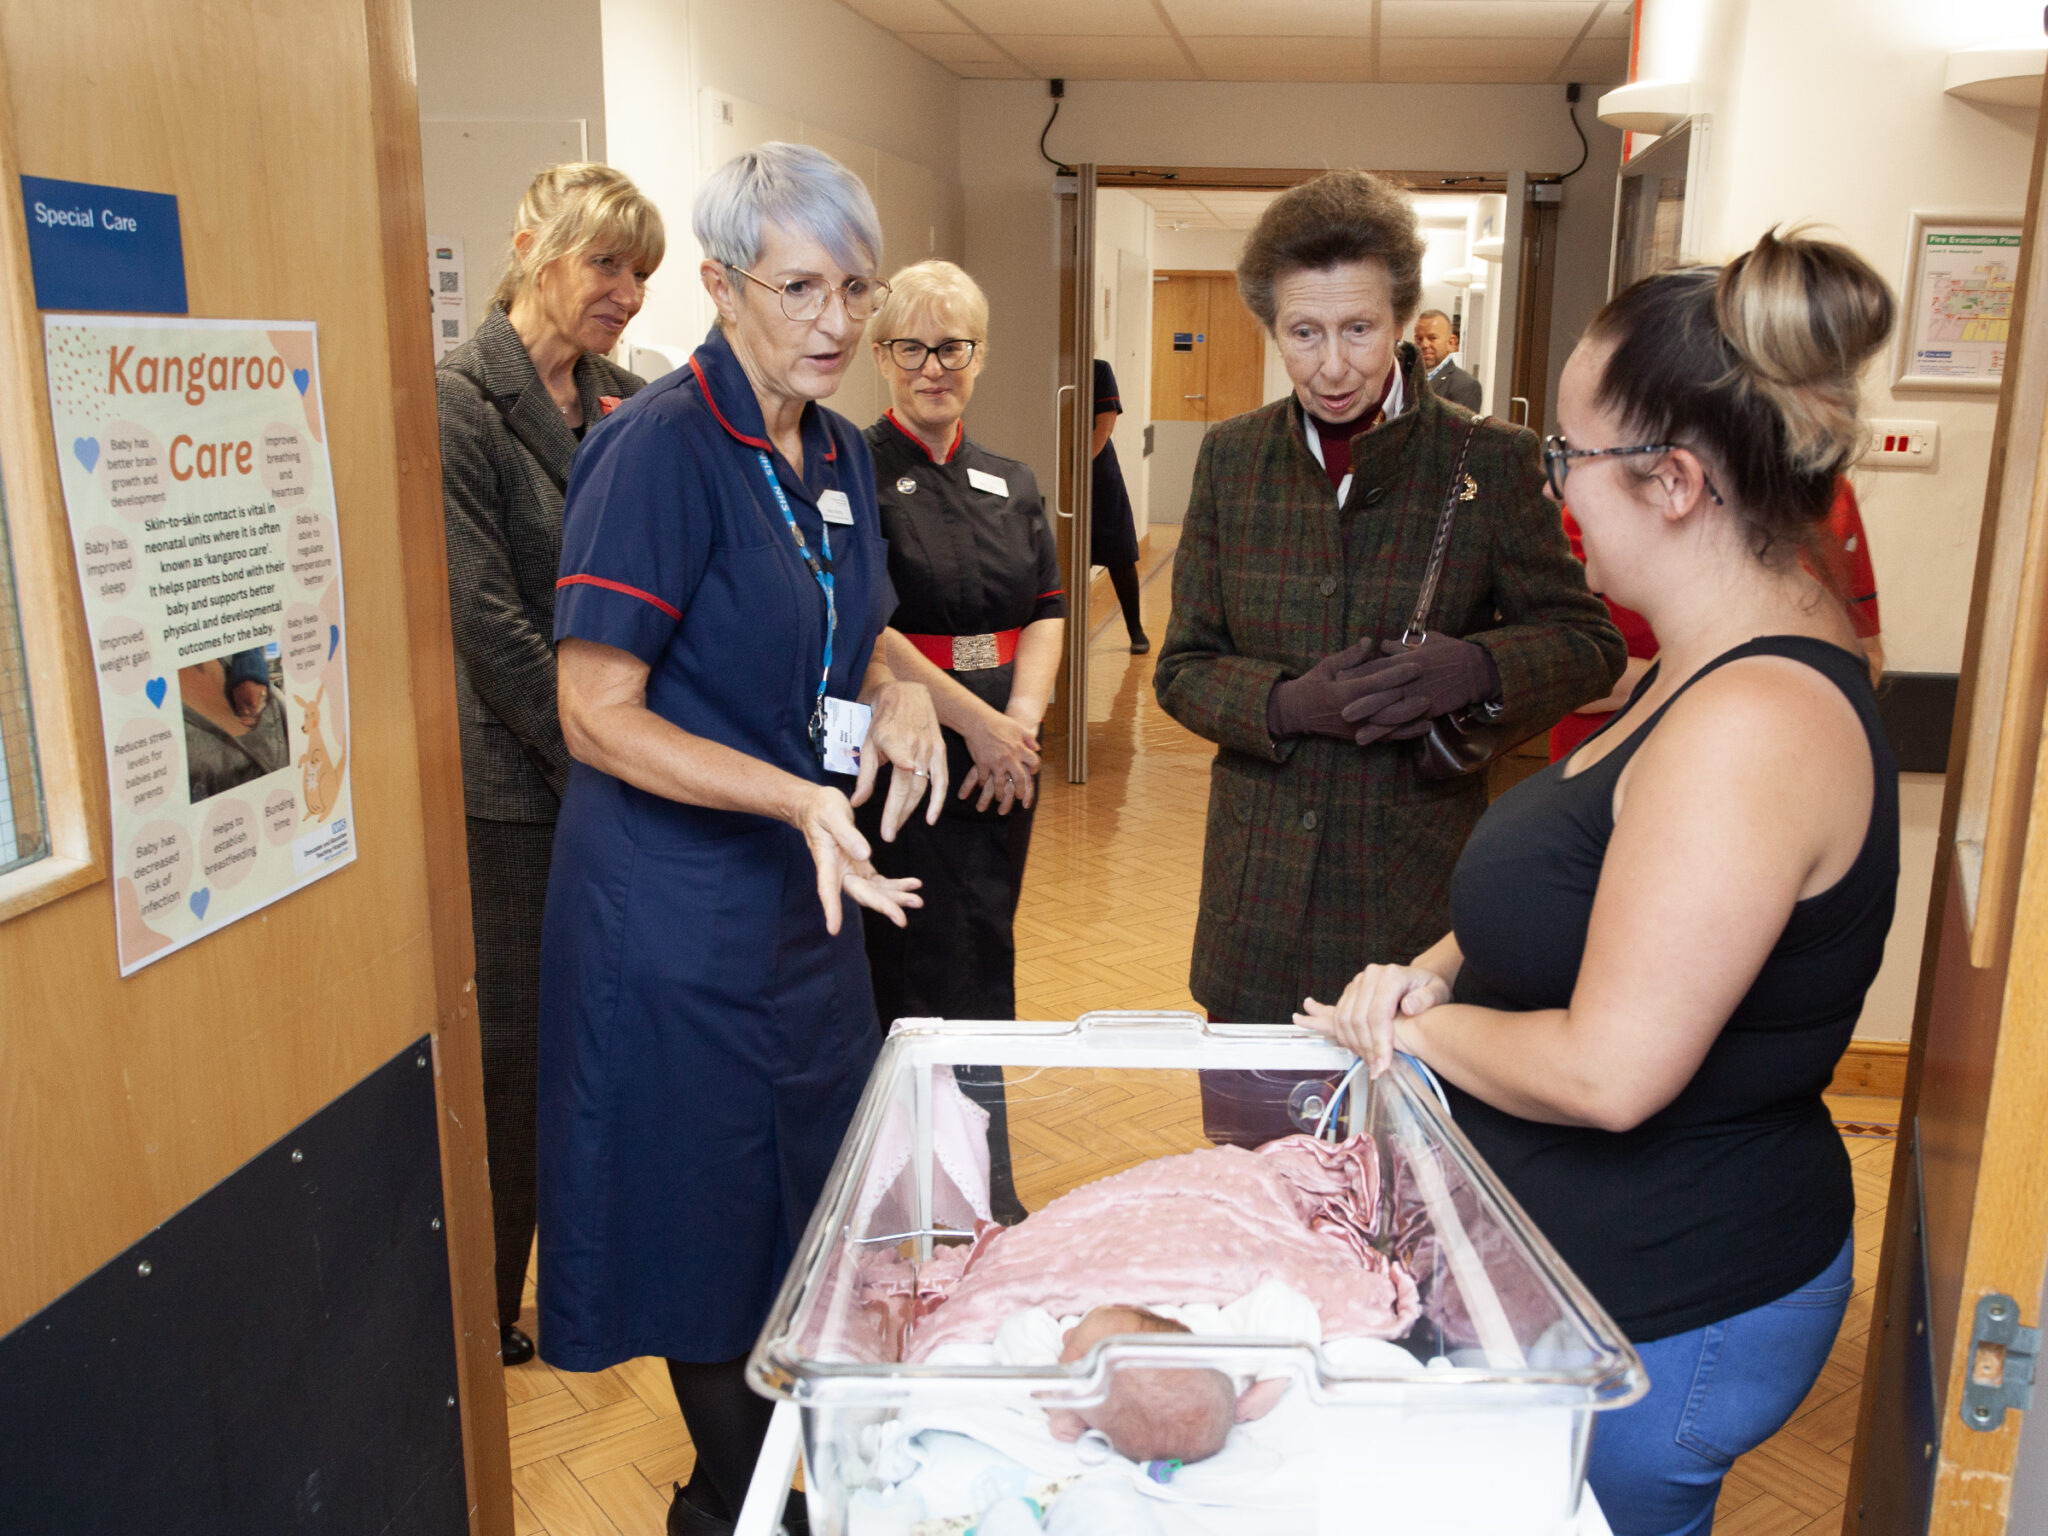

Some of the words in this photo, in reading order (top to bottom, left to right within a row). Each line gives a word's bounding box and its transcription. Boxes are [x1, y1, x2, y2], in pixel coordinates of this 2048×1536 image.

[34, 202, 94, 228] Special
[101, 209, 138, 233] Care
[1929, 235, 1947, 244] Fire
[1948, 235, 1998, 245] Evacuation
[1999, 236, 2020, 246] Plan
[108, 345, 285, 406] Kangaroo
[110, 439, 132, 452] Baby
[134, 438, 150, 449] has
[106, 459, 133, 470] better
[135, 456, 158, 468] brain
[169, 434, 253, 482] Care
[266, 452, 301, 464] breathing
[758, 451, 773, 476] NHS
[111, 477, 141, 491] growth
[143, 474, 159, 485] and
[279, 469, 293, 480] and
[110, 492, 167, 508] development
[773, 486, 790, 512] NHS
[144, 512, 201, 532] Skin-to-skin
[203, 508, 237, 524] contact
[238, 506, 246, 518] is
[247, 502, 266, 516] vital
[267, 502, 276, 513] in
[85, 541, 109, 555] Baby
[111, 538, 129, 550] has
[144, 535, 187, 554] neonatal
[188, 532, 211, 547] units
[213, 529, 240, 543] where
[241, 526, 248, 538] it
[249, 525, 257, 536] is
[258, 522, 281, 535] often
[86, 557, 133, 577] improved
[160, 558, 191, 573] known
[193, 556, 203, 567] as
[100, 582, 126, 596] sleep
[149, 584, 158, 598] It
[158, 581, 185, 597] helps
[186, 574, 220, 593] parents
[222, 568, 244, 583] bond
[246, 564, 265, 578] with
[265, 559, 286, 575] their
[166, 601, 190, 617] baby
[191, 596, 208, 611] and
[209, 589, 248, 607] supports
[249, 583, 276, 598] better
[163, 617, 201, 642] physical
[202, 614, 219, 629] and
[220, 600, 283, 624] developmental
[99, 629, 144, 650] Improved
[178, 638, 222, 656] outcomes
[223, 632, 236, 645] for
[237, 627, 252, 640] the
[253, 622, 276, 638] baby.
[100, 655, 131, 672] weight
[132, 649, 151, 667] gain
[114, 738, 148, 757] Reduces
[149, 730, 172, 745] stress
[127, 755, 150, 770] levels
[151, 750, 162, 761] for
[125, 773, 152, 789] babies
[153, 764, 167, 779] and
[133, 785, 164, 806] parents
[265, 797, 295, 818] Bonding
[213, 820, 235, 836] Helps
[235, 817, 244, 827] to
[136, 842, 159, 859] Baby
[160, 834, 176, 848] has
[213, 831, 248, 854] establish
[134, 849, 180, 880] decreased
[145, 879, 161, 895] risk
[162, 871, 172, 887] of
[141, 890, 181, 916] infection
